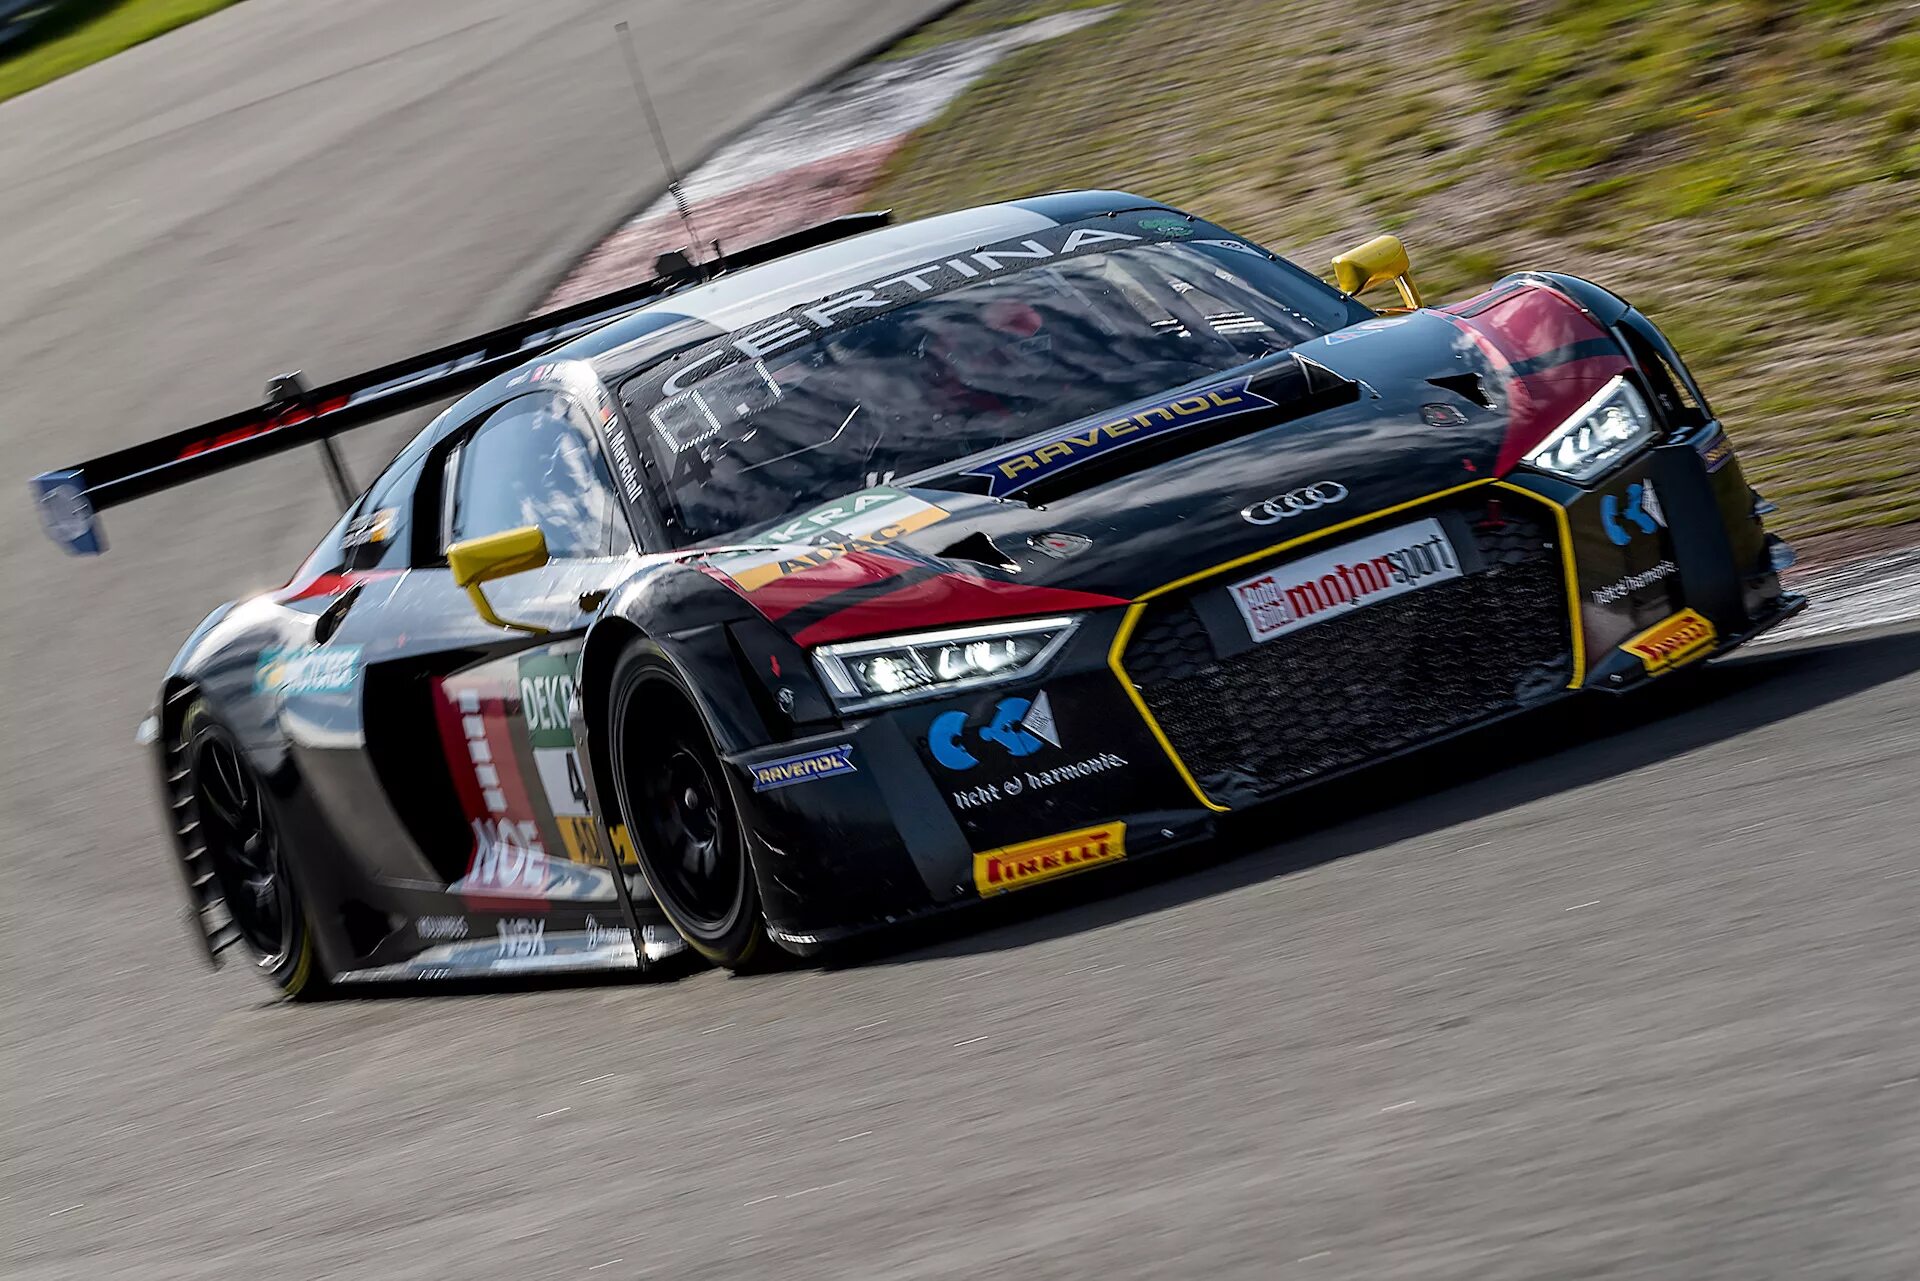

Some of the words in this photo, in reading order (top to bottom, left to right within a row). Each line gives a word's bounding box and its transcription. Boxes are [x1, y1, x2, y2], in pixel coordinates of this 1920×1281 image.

[662, 228, 1142, 396] CERTINA
[609, 429, 644, 504] Marschall
[997, 391, 1243, 479] RAVENOL
[758, 754, 844, 784] RAVENOL
[953, 784, 1002, 809] licht
[1025, 752, 1129, 790] harmonie
[985, 831, 1112, 884] PIRELLI
